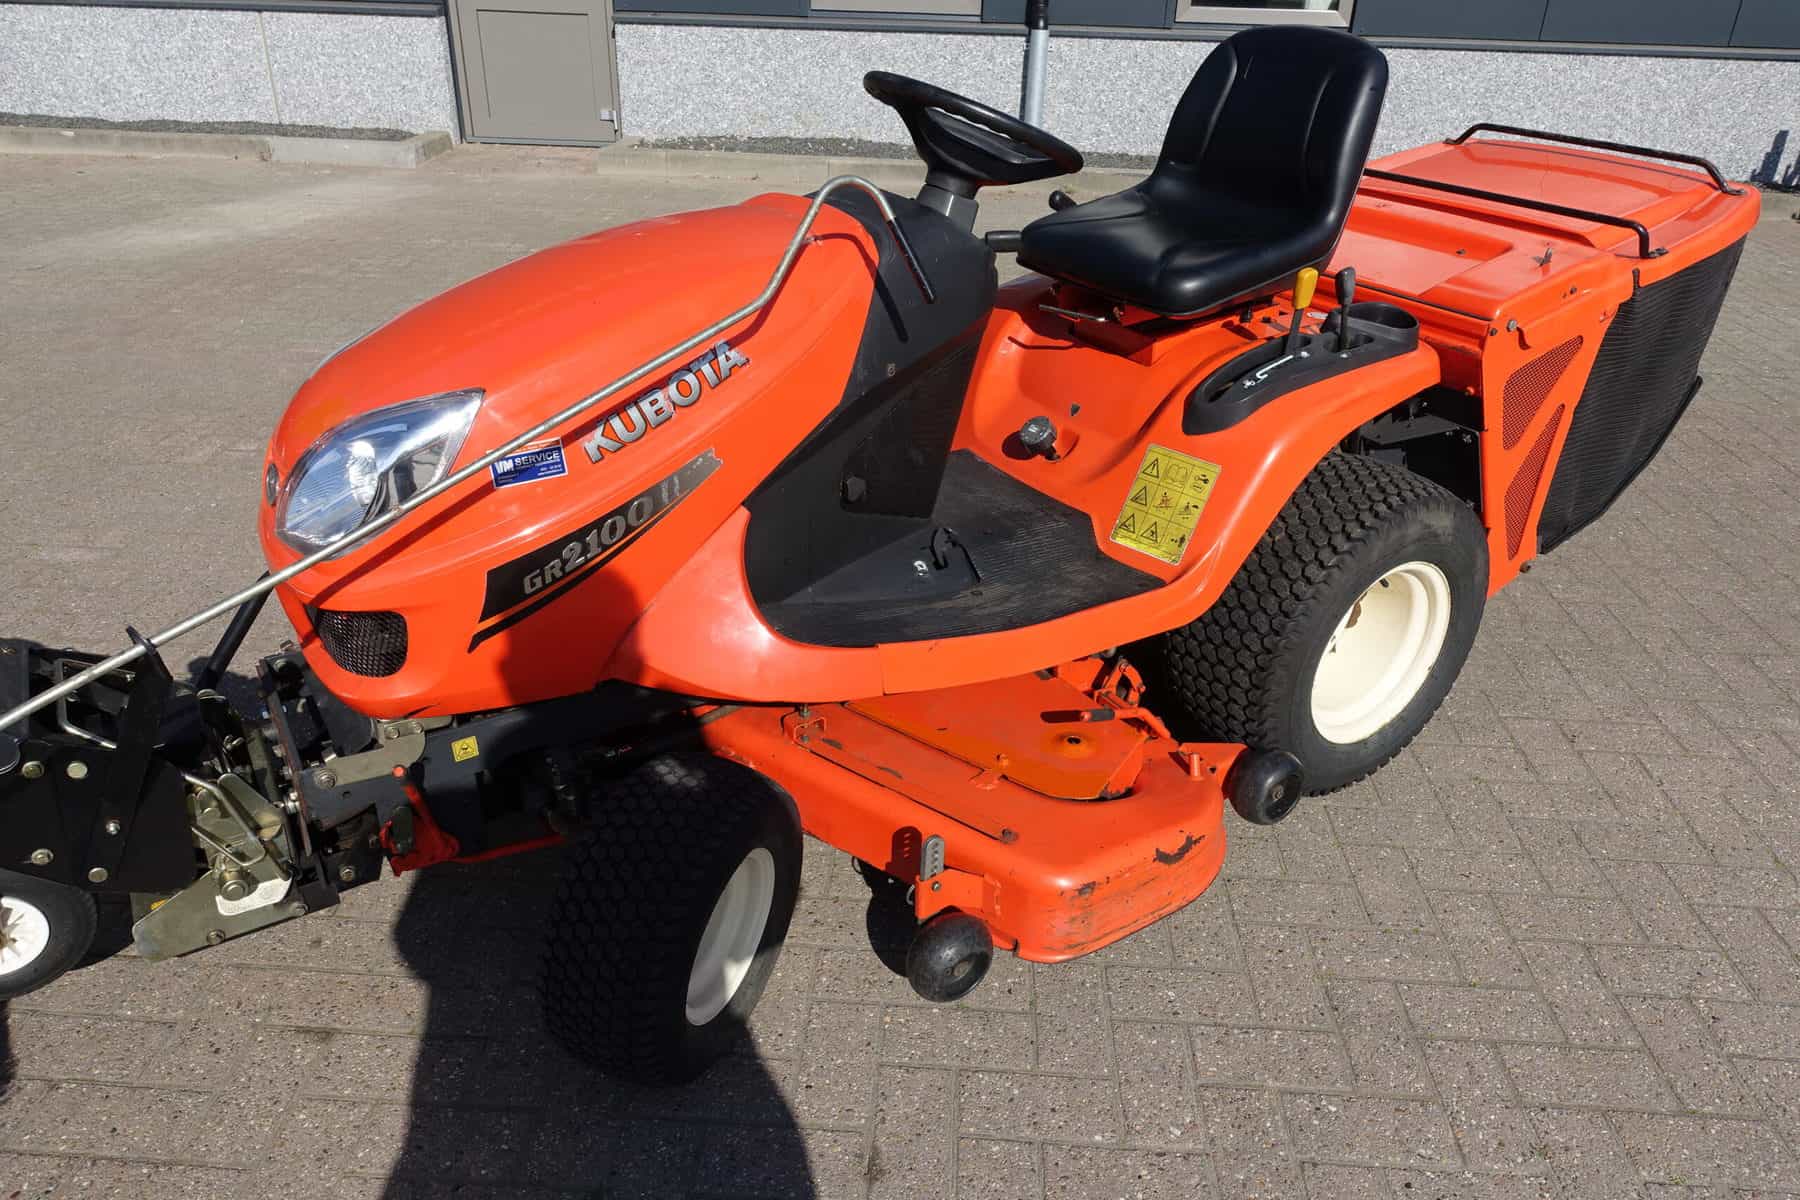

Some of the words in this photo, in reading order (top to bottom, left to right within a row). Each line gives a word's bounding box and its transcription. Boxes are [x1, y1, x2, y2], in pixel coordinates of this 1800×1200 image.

[584, 339, 749, 463] KUBOTA
[515, 450, 560, 466] SERVICE
[523, 496, 653, 595] GR2100
